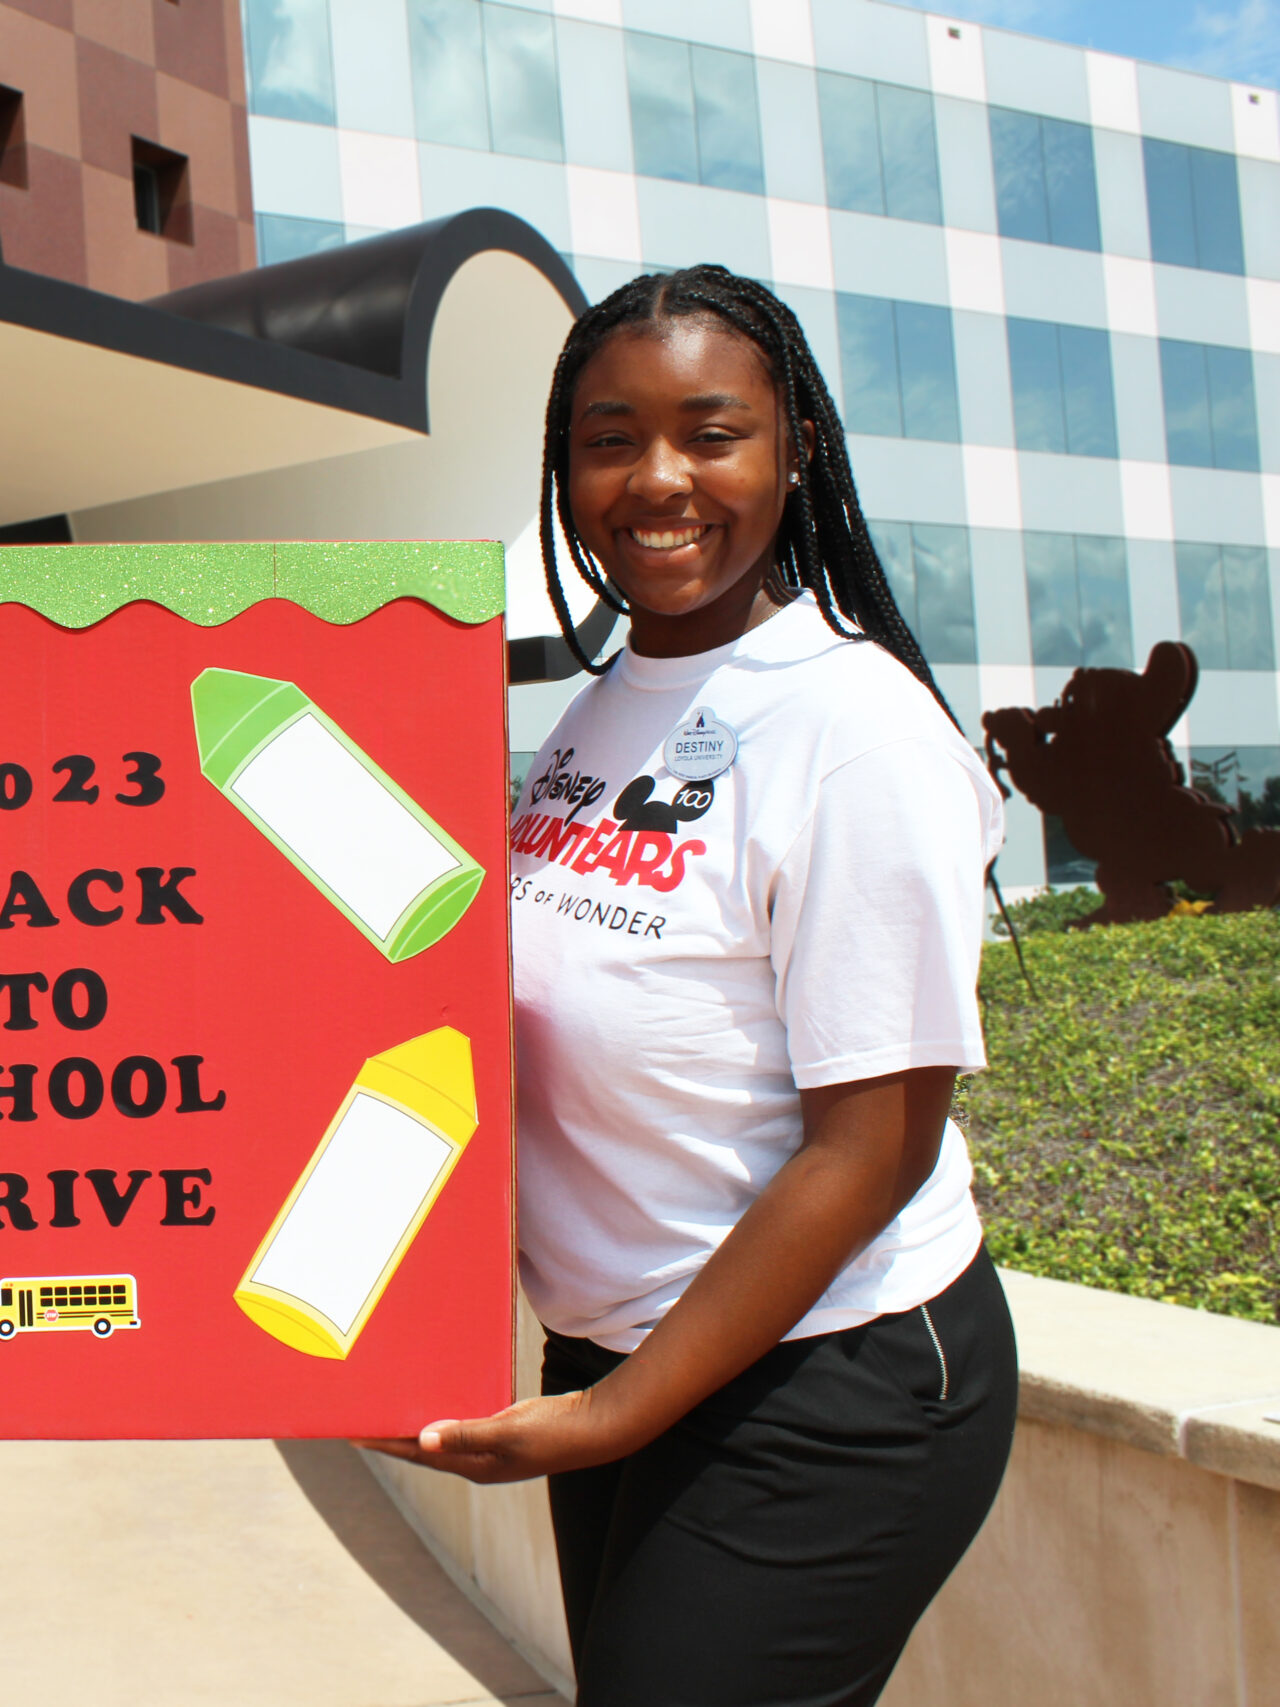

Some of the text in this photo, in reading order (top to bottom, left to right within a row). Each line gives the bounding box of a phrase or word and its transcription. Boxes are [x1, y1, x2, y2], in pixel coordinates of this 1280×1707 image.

[675, 740, 724, 754] DESTINY
[676, 789, 712, 809] 100
[534, 889, 667, 940] OF WONDER
